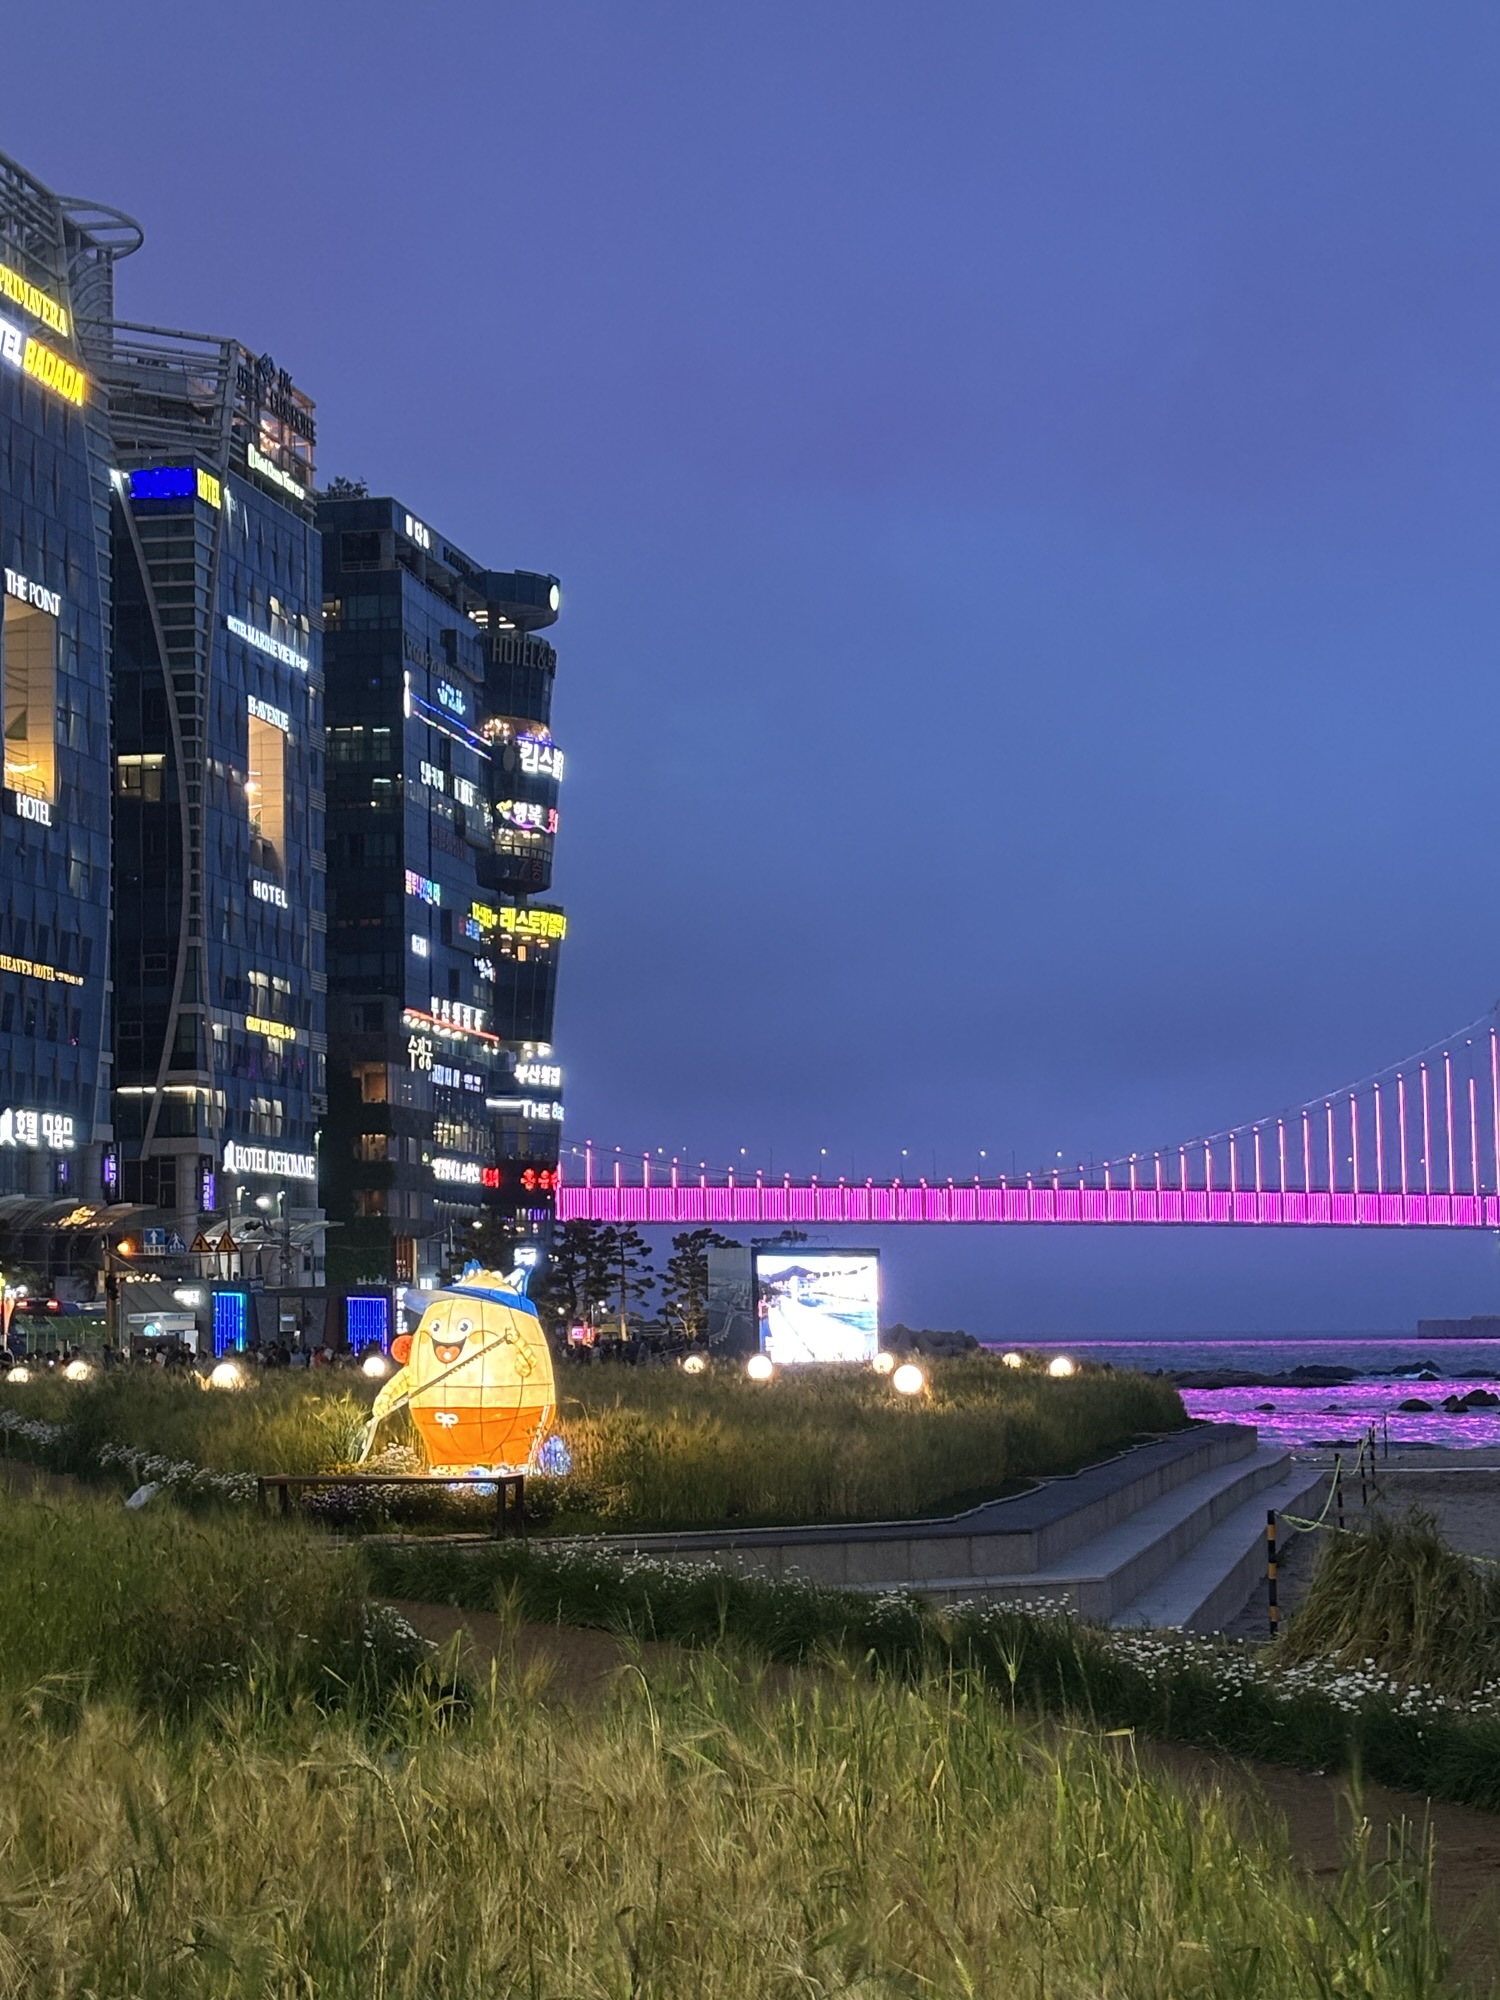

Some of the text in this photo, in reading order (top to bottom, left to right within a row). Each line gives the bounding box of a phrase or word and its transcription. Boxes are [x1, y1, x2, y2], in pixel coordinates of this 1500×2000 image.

[23, 338, 84, 407] BADADA
[197, 467, 221, 510] HOTEL
[5, 568, 61, 617] THE POINT
[227, 614, 248, 639] HOTEL
[16, 793, 52, 827] HOTEL
[253, 880, 288, 909] HOTEL
[0, 954, 32, 975] HEAVEN
[33, 963, 55, 982] HOTEL
[407, 1035, 433, 1072] 수정궁
[520, 1100, 550, 1118] THE
[15, 1109, 38, 1147] 호텔
[236, 1146, 269, 1173] HOTEL
